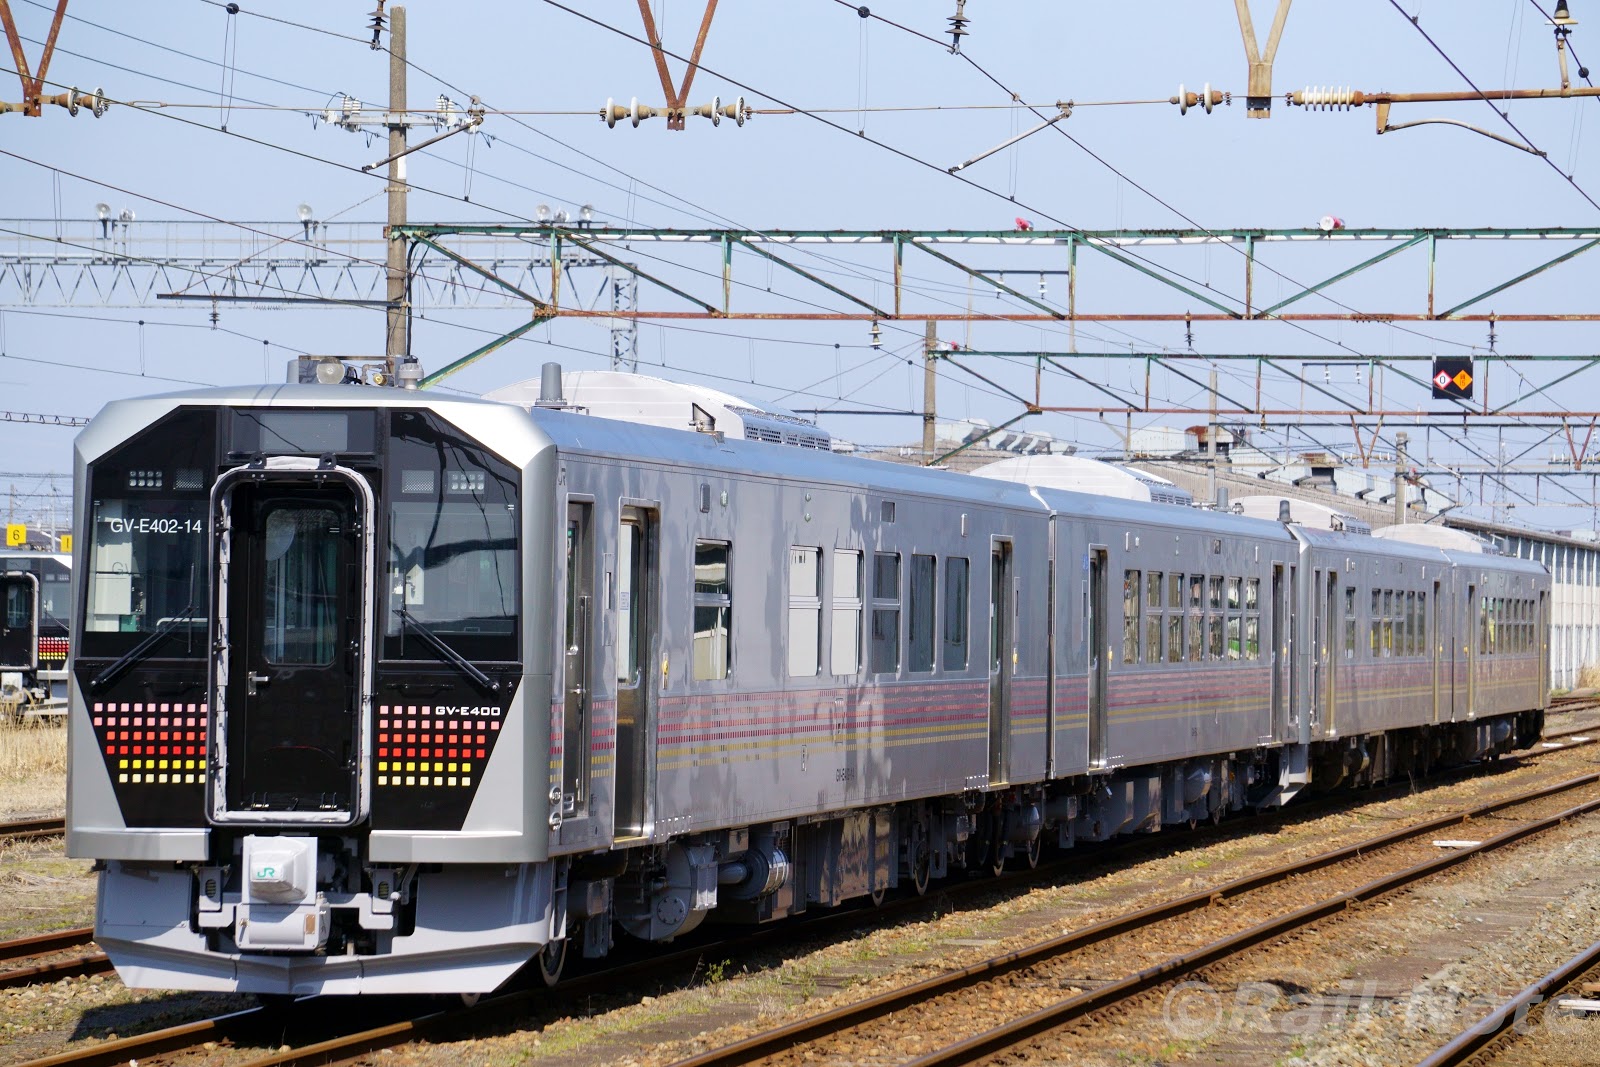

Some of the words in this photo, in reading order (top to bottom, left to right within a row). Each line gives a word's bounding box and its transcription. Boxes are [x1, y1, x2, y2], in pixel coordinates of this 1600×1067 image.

[1440, 375, 1446, 384] 0
[111, 519, 202, 534] GV-E402-14
[12, 529, 20, 541] 6
[435, 706, 501, 716] GV-E400
[257, 867, 275, 878] JR
